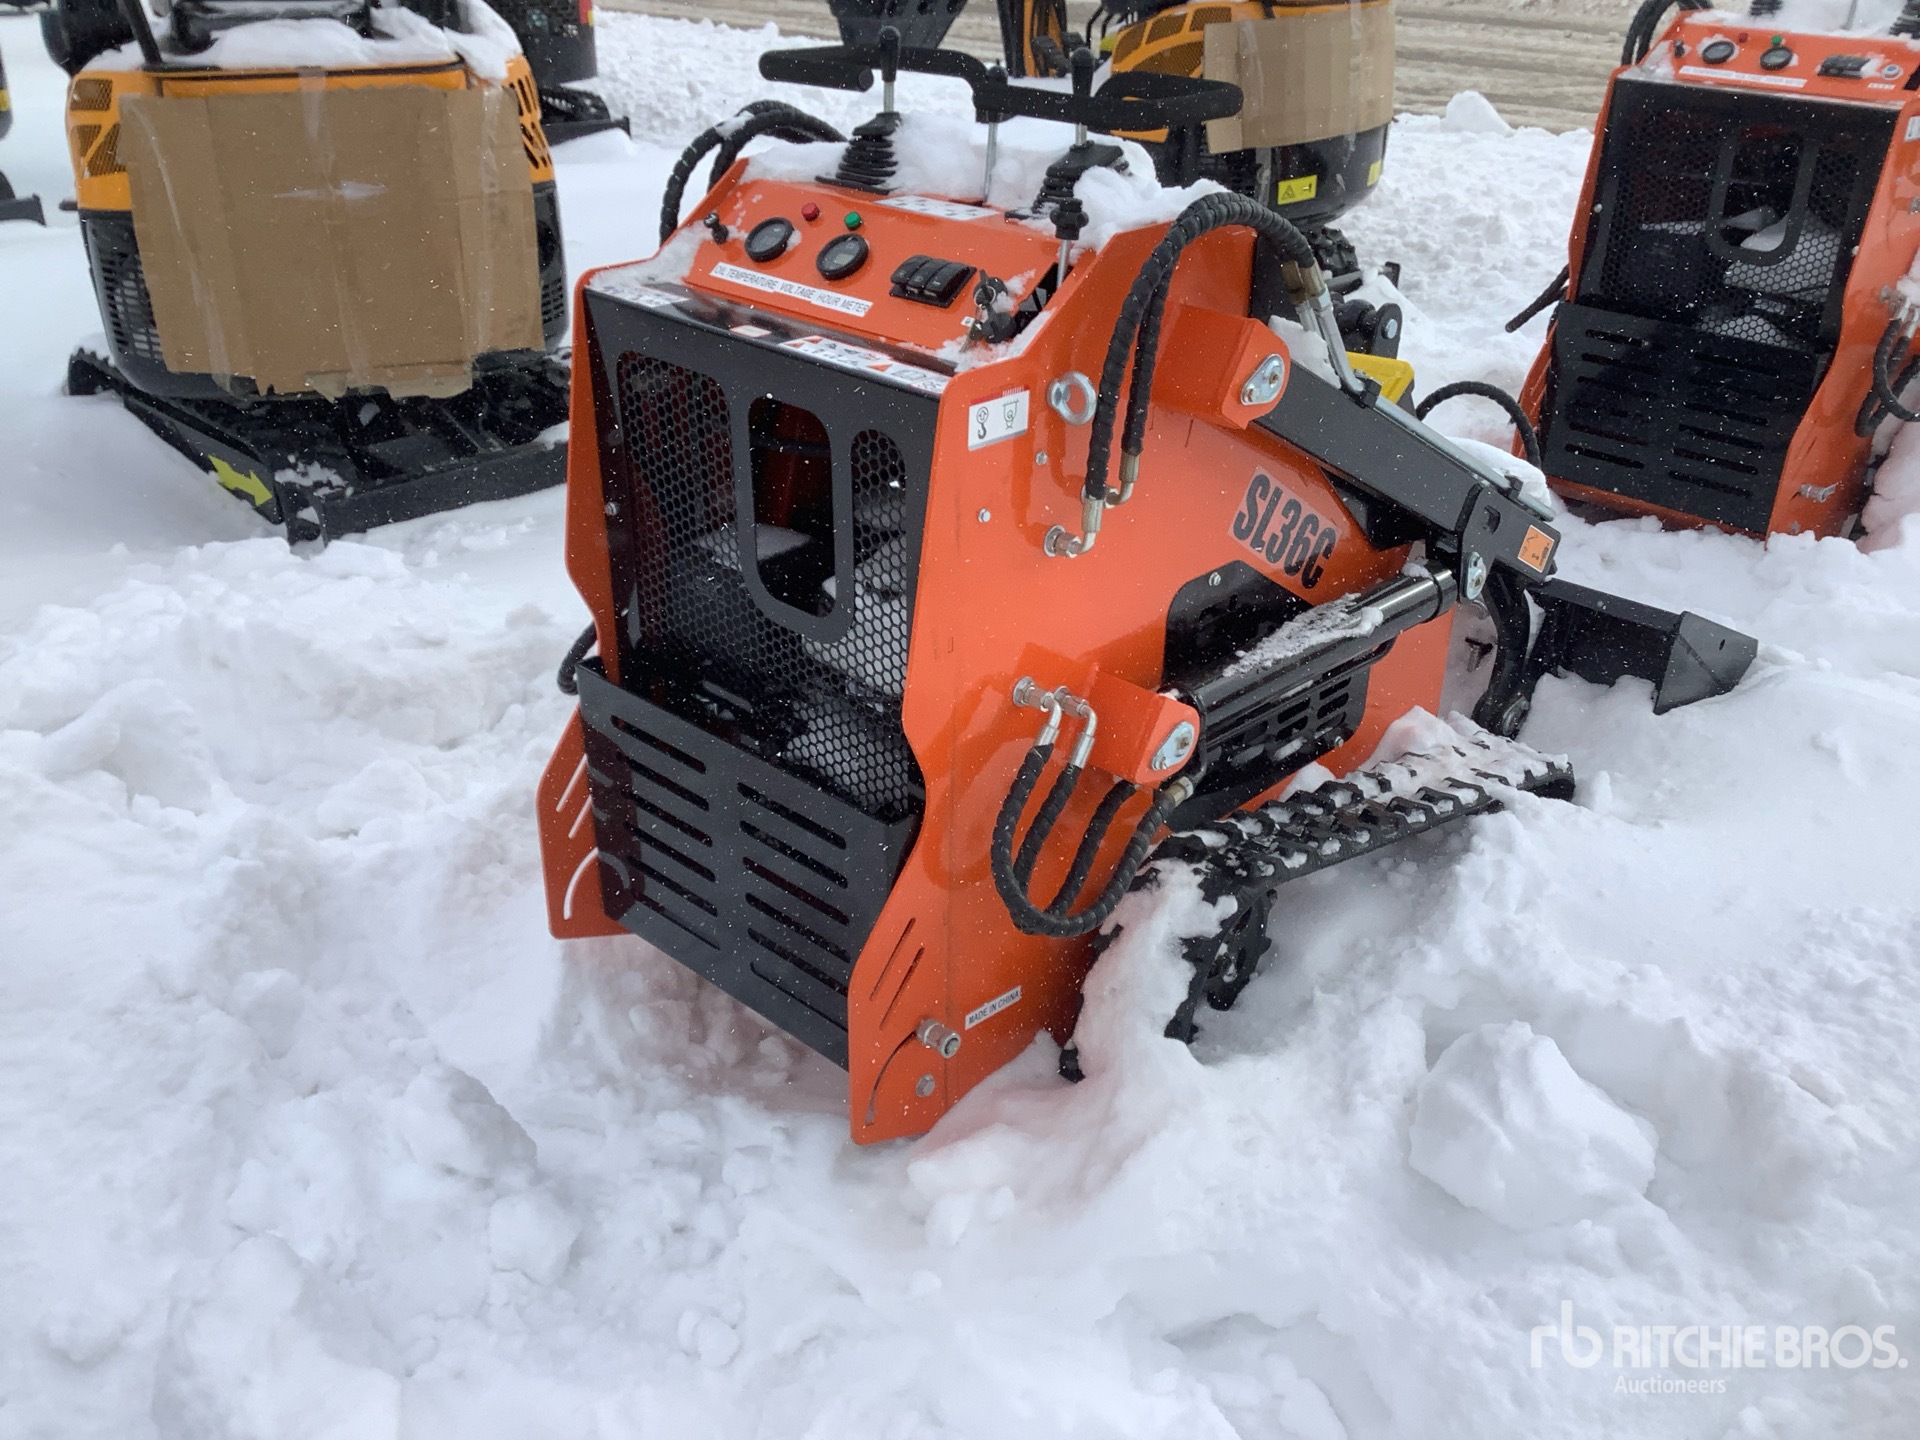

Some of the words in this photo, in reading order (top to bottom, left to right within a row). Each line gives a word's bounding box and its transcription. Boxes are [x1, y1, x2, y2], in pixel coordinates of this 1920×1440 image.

[713, 265, 727, 276] OIL
[727, 268, 778, 290] TEMPERATURE
[779, 282, 816, 299] VOLTAGE
[816, 292, 841, 306] HOUR
[841, 299, 870, 313] METER
[1233, 474, 1336, 589] SL36C
[968, 1007, 987, 1024] MADE
[989, 1002, 997, 1013] IN
[998, 990, 1019, 1009] CHINA
